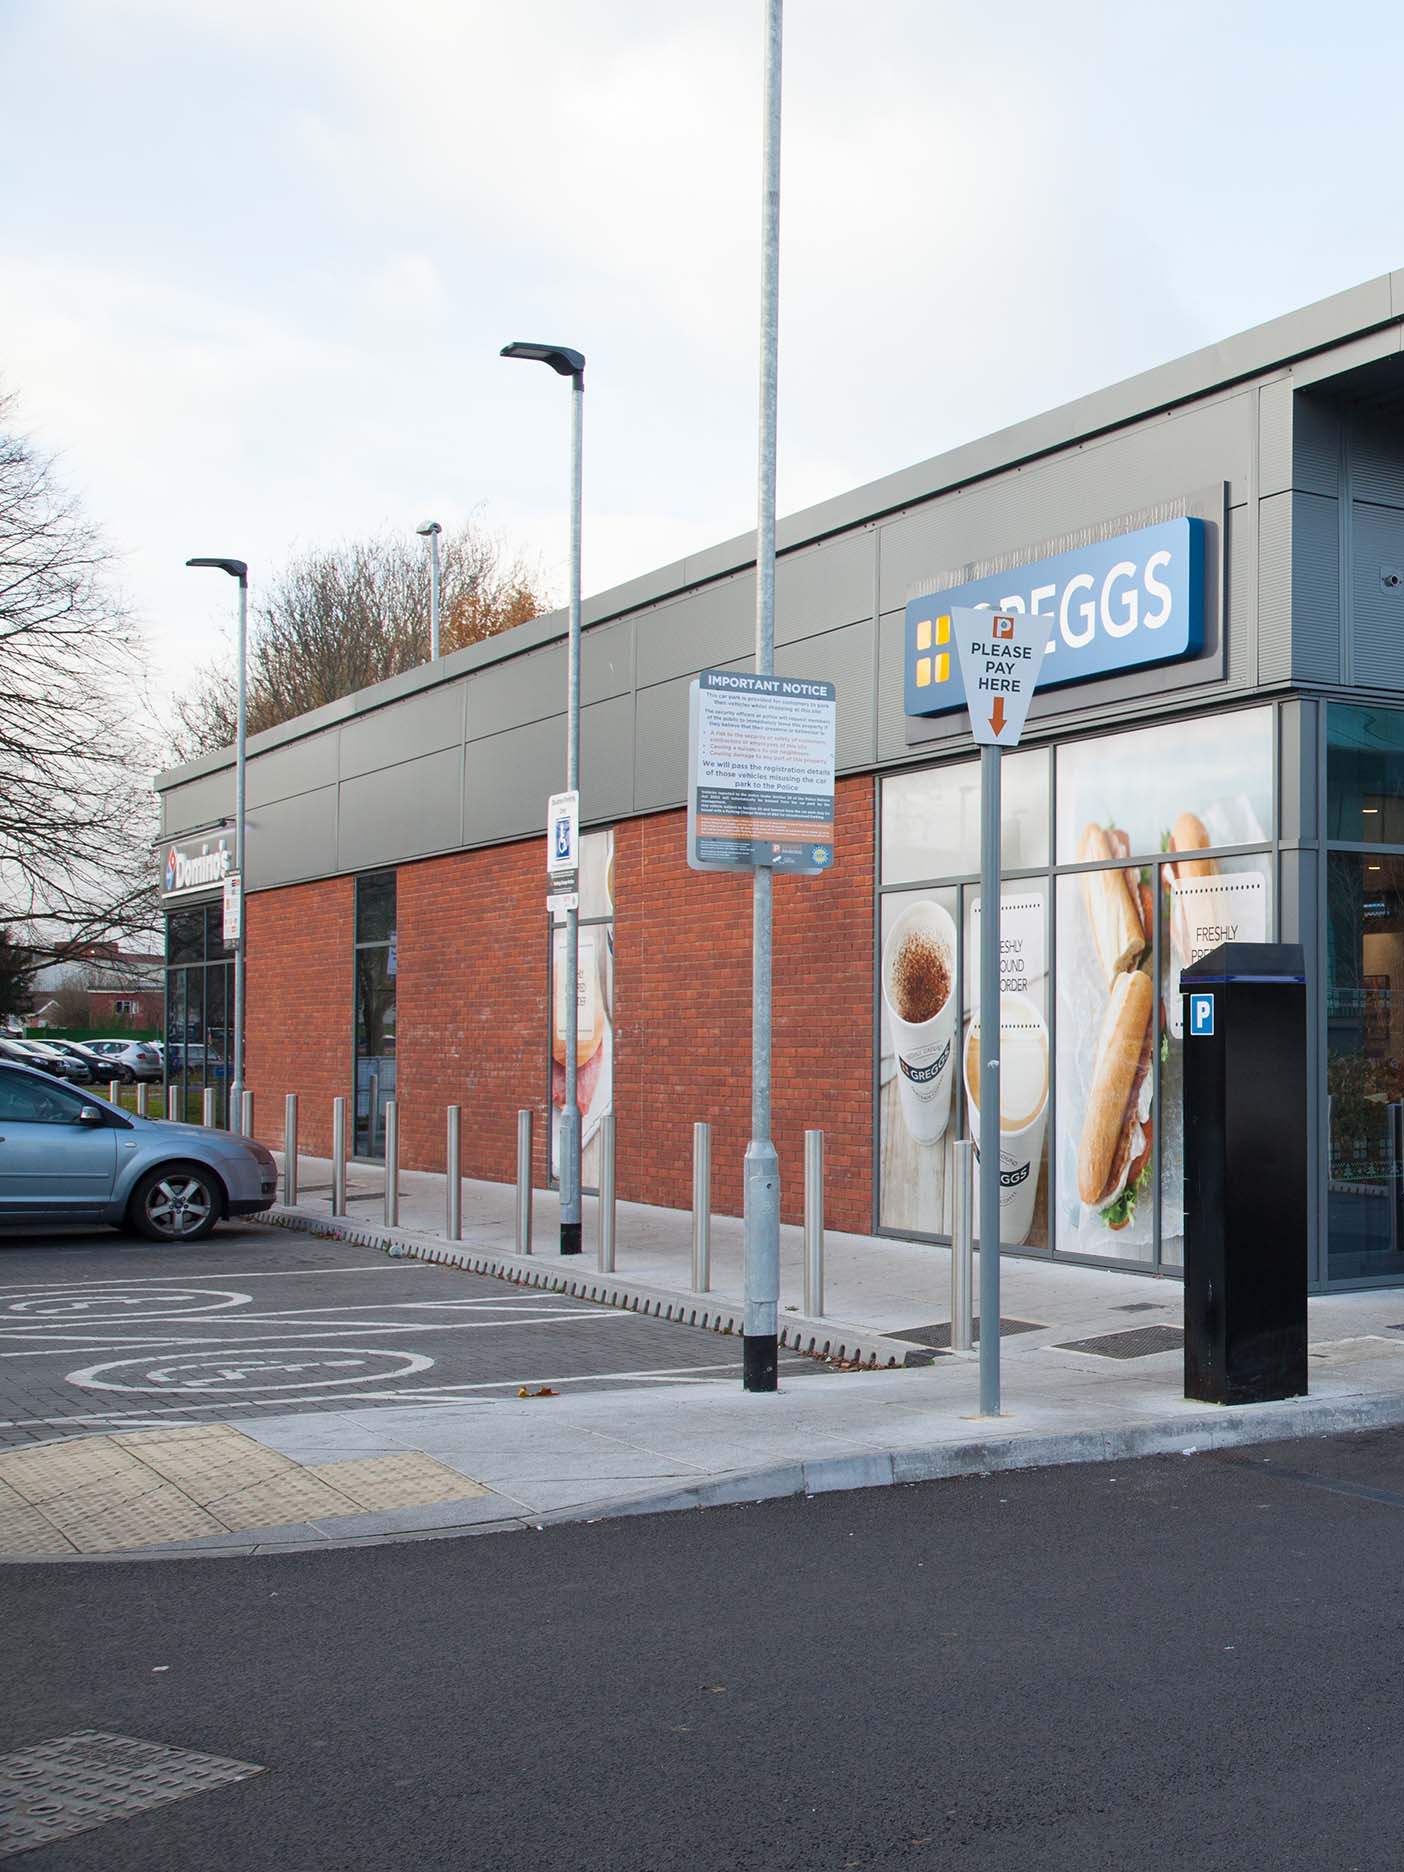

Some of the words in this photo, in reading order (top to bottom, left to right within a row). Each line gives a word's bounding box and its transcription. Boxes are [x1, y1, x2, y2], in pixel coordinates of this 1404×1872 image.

[972, 550, 1172, 654] EGGS
[971, 642, 1032, 660] PLEASE
[985, 661, 1015, 676] PAY
[708, 675, 780, 692] IMPORTANT
[783, 683, 828, 696] NOTICE
[978, 677, 1021, 693] HERE
[703, 760, 716, 768] We
[717, 761, 729, 769] will
[732, 764, 747, 772] pass
[763, 765, 806, 776] registration
[807, 768, 830, 776] details
[735, 781, 751, 790] park
[777, 783, 798, 791] Police
[738, 772, 767, 780] vehicles
[769, 775, 800, 785] misusing
[175, 840, 231, 888] Domino's
[1196, 925, 1238, 941] FRESHLY
[1000, 939, 1023, 953] ESHLY
[1000, 959, 1024, 973] OUND
[1000, 978, 1028, 992] ORDER
[1197, 1001, 1210, 1028] P
[911, 1045, 950, 1080] GREGGS
[1000, 1167, 1027, 1184] GGS
